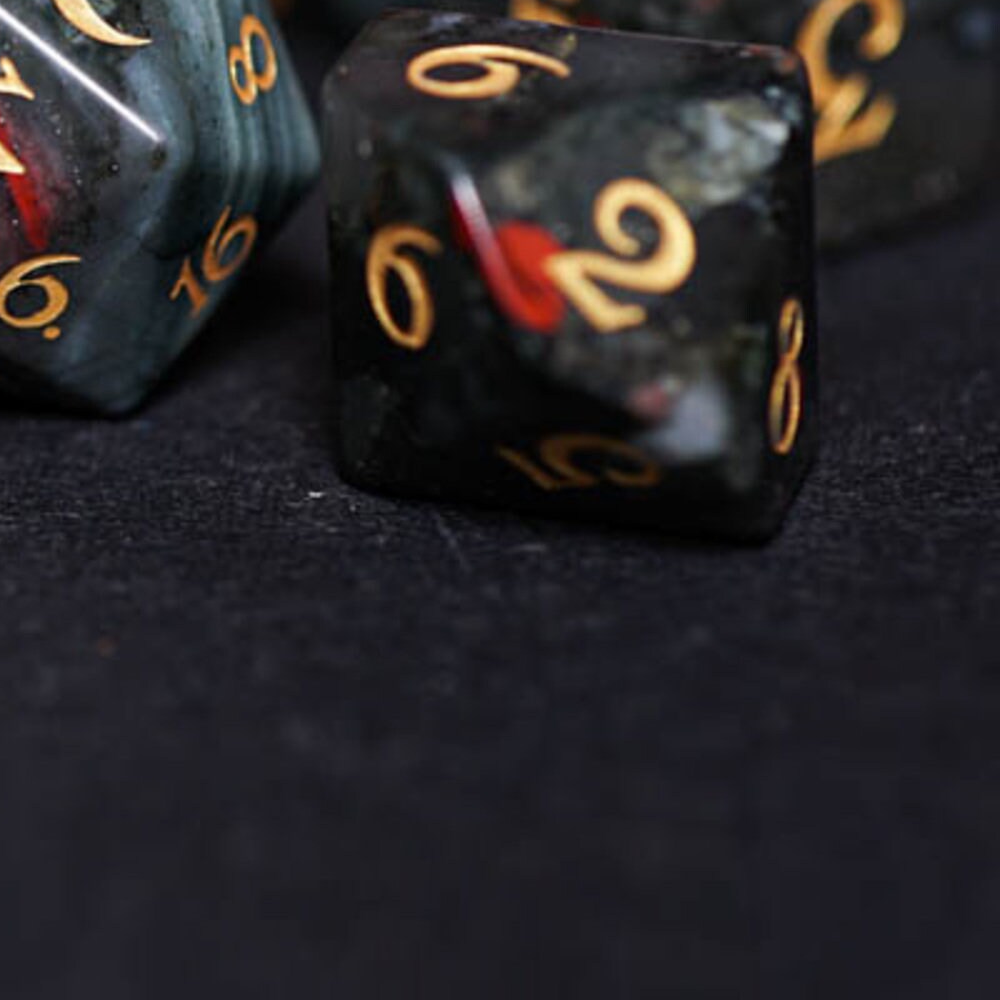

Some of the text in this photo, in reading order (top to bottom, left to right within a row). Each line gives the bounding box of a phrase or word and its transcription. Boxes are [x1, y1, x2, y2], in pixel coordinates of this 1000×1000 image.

[228, 15, 277, 105] 8
[170, 206, 257, 317] 16
[544, 178, 696, 332] 2
[770, 299, 804, 454] 8
